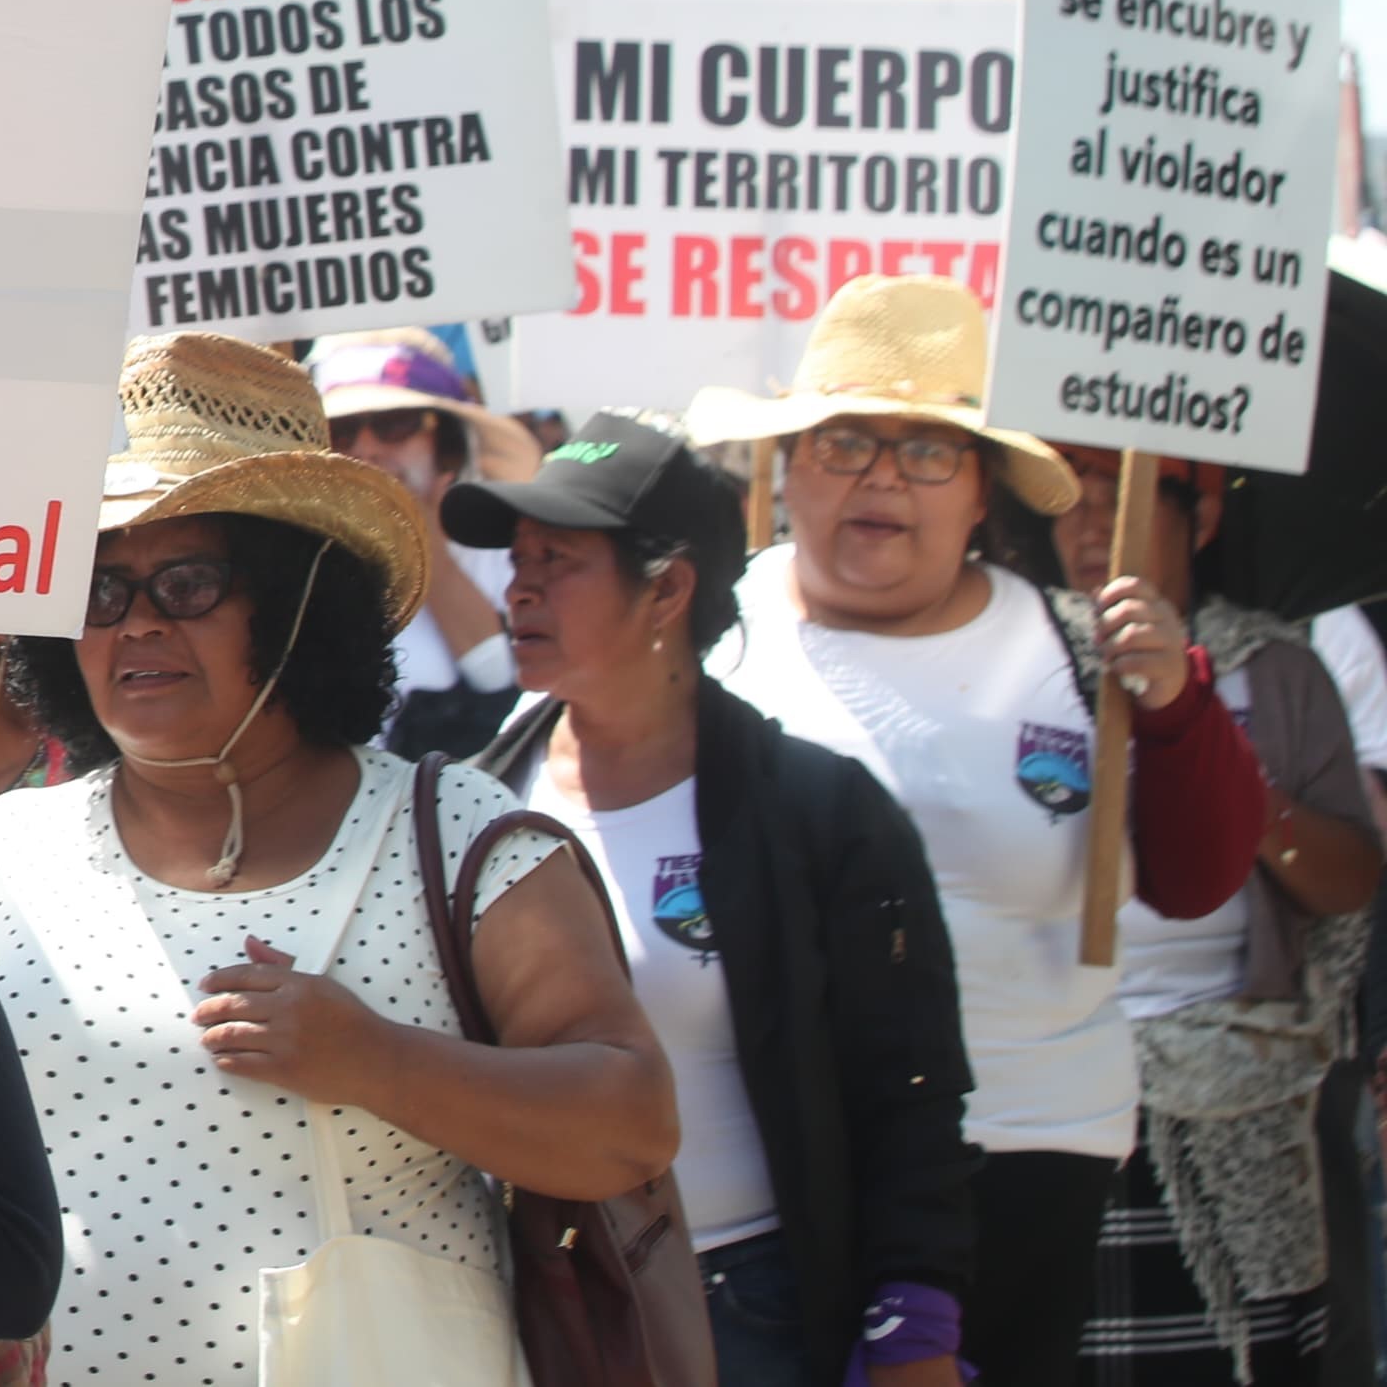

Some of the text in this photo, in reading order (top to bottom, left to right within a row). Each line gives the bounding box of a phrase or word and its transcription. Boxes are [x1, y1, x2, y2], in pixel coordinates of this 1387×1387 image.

[1287, 19, 1312, 71] y
[308, 60, 372, 116] DE
[574, 40, 1014, 134] MI CUERPO
[1100, 51, 1262, 127] justifica
[290, 111, 492, 183] CONTRA
[568, 146, 1001, 216] MI TERRITORIO
[1070, 128, 1287, 207] al violador
[202, 181, 426, 259] MUJERES
[1037, 209, 1302, 289] cuando es un
[144, 245, 435, 328] FEMICIDIOS
[567, 231, 647, 316] SE
[1016, 287, 1306, 366] compañero de
[1058, 371, 1252, 436] estudios?
